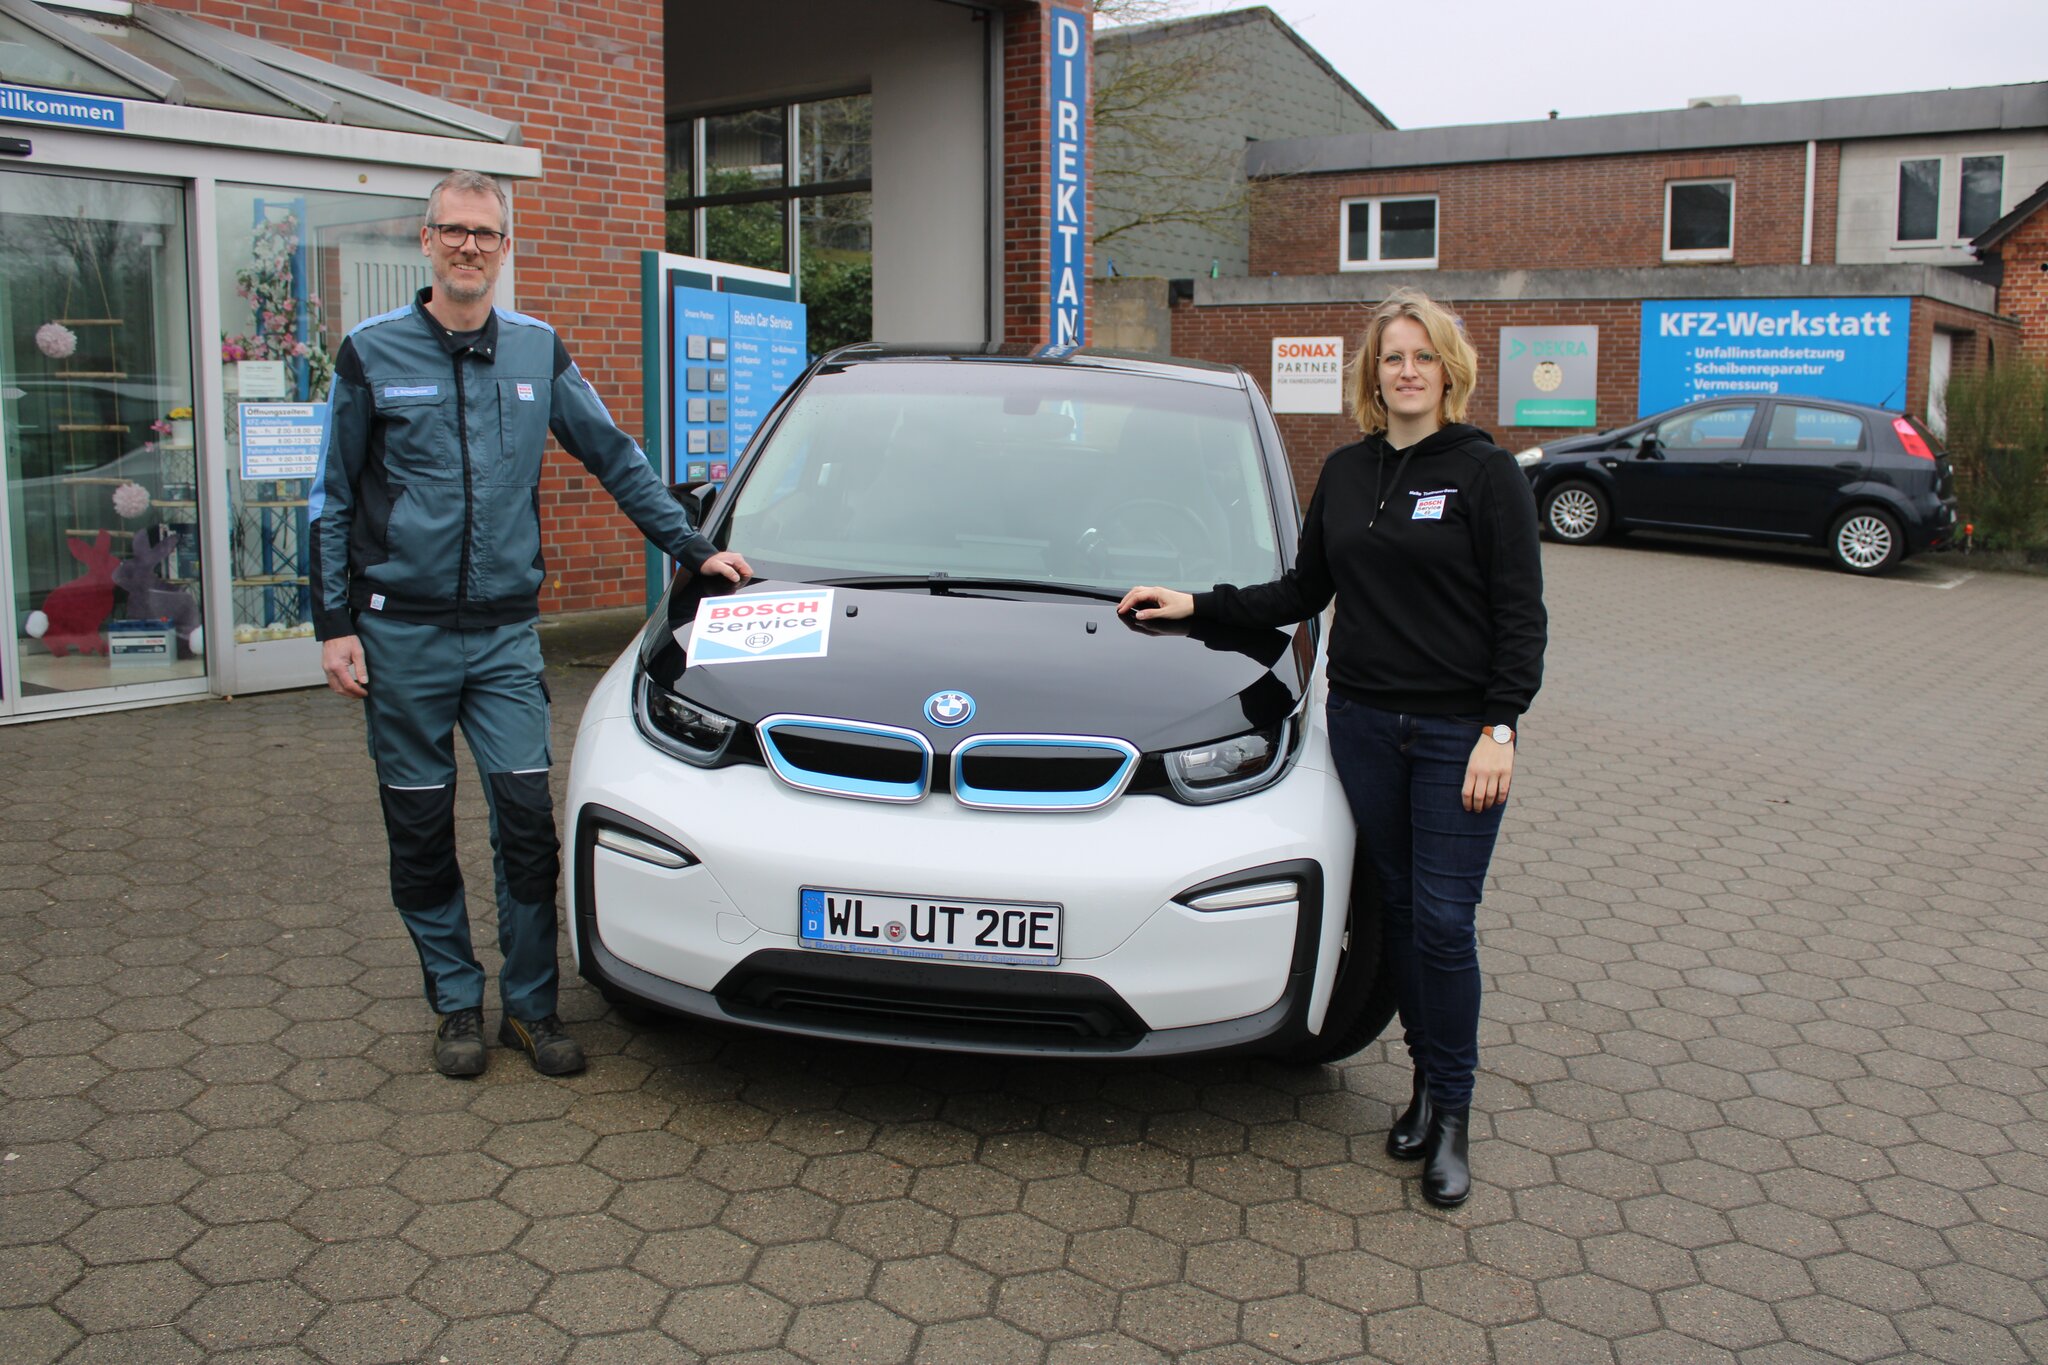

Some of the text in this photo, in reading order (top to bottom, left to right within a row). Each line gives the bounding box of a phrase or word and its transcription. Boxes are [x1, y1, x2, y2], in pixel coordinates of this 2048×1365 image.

[0, 90, 115, 121] illkommen
[734, 310, 793, 330] Bosch Car Service
[1660, 310, 1891, 337] KFZ-Werkstatt
[1277, 344, 1336, 357] SONAX
[1532, 340, 1588, 357] DEKRA
[1695, 347, 1845, 361] Unfallinstandsetzung
[1278, 362, 1337, 372] PARTNER
[1694, 363, 1825, 377] Scheibenreparatur
[1694, 379, 1778, 392] Vermessung
[247, 408, 309, 417] Öffnungszeiten:
[710, 601, 819, 619] BOSCH
[707, 617, 817, 633] Service
[808, 920, 818, 931] D
[827, 898, 1054, 949] WL UT 20E
[816, 942, 846, 951] Bosch
[849, 944, 888, 954] Service
[891, 947, 944, 959] Theilmann
[958, 952, 989, 961] 21376
